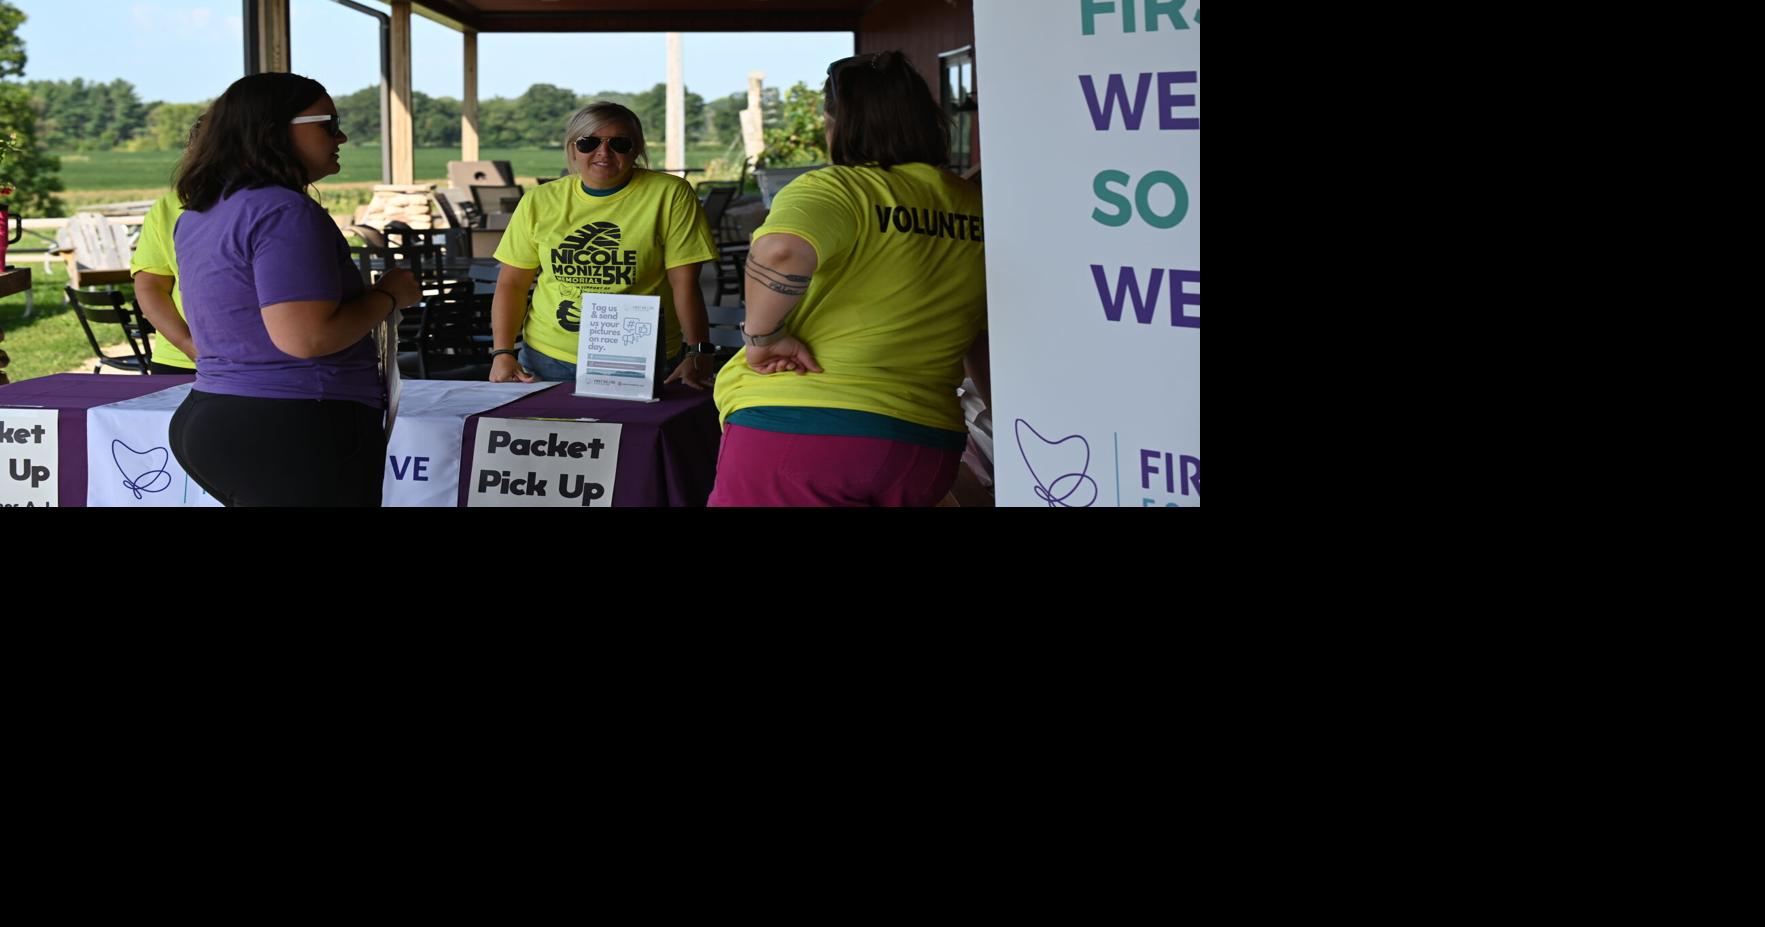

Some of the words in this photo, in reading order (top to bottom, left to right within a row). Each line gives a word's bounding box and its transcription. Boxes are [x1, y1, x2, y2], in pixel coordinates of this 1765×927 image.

[1080, 0, 1200, 35] FIR
[1078, 71, 1200, 131] WE
[1091, 169, 1189, 229] SO
[875, 204, 985, 242] VOLUNTE
[551, 248, 637, 265] NICOLE
[552, 264, 602, 276] MONIZ
[602, 265, 632, 286] 5K
[555, 275, 601, 285] MEMORIAL
[591, 303, 607, 312] Tag
[1089, 264, 1200, 329] WE
[590, 311, 598, 319] &
[599, 312, 618, 320] send
[601, 321, 620, 329] your
[589, 327, 621, 336] pictures
[588, 343, 606, 352] day.
[487, 430, 605, 459] Packet
[9, 458, 50, 488] Up
[478, 469, 548, 497] Pick
[558, 473, 605, 507] Up
